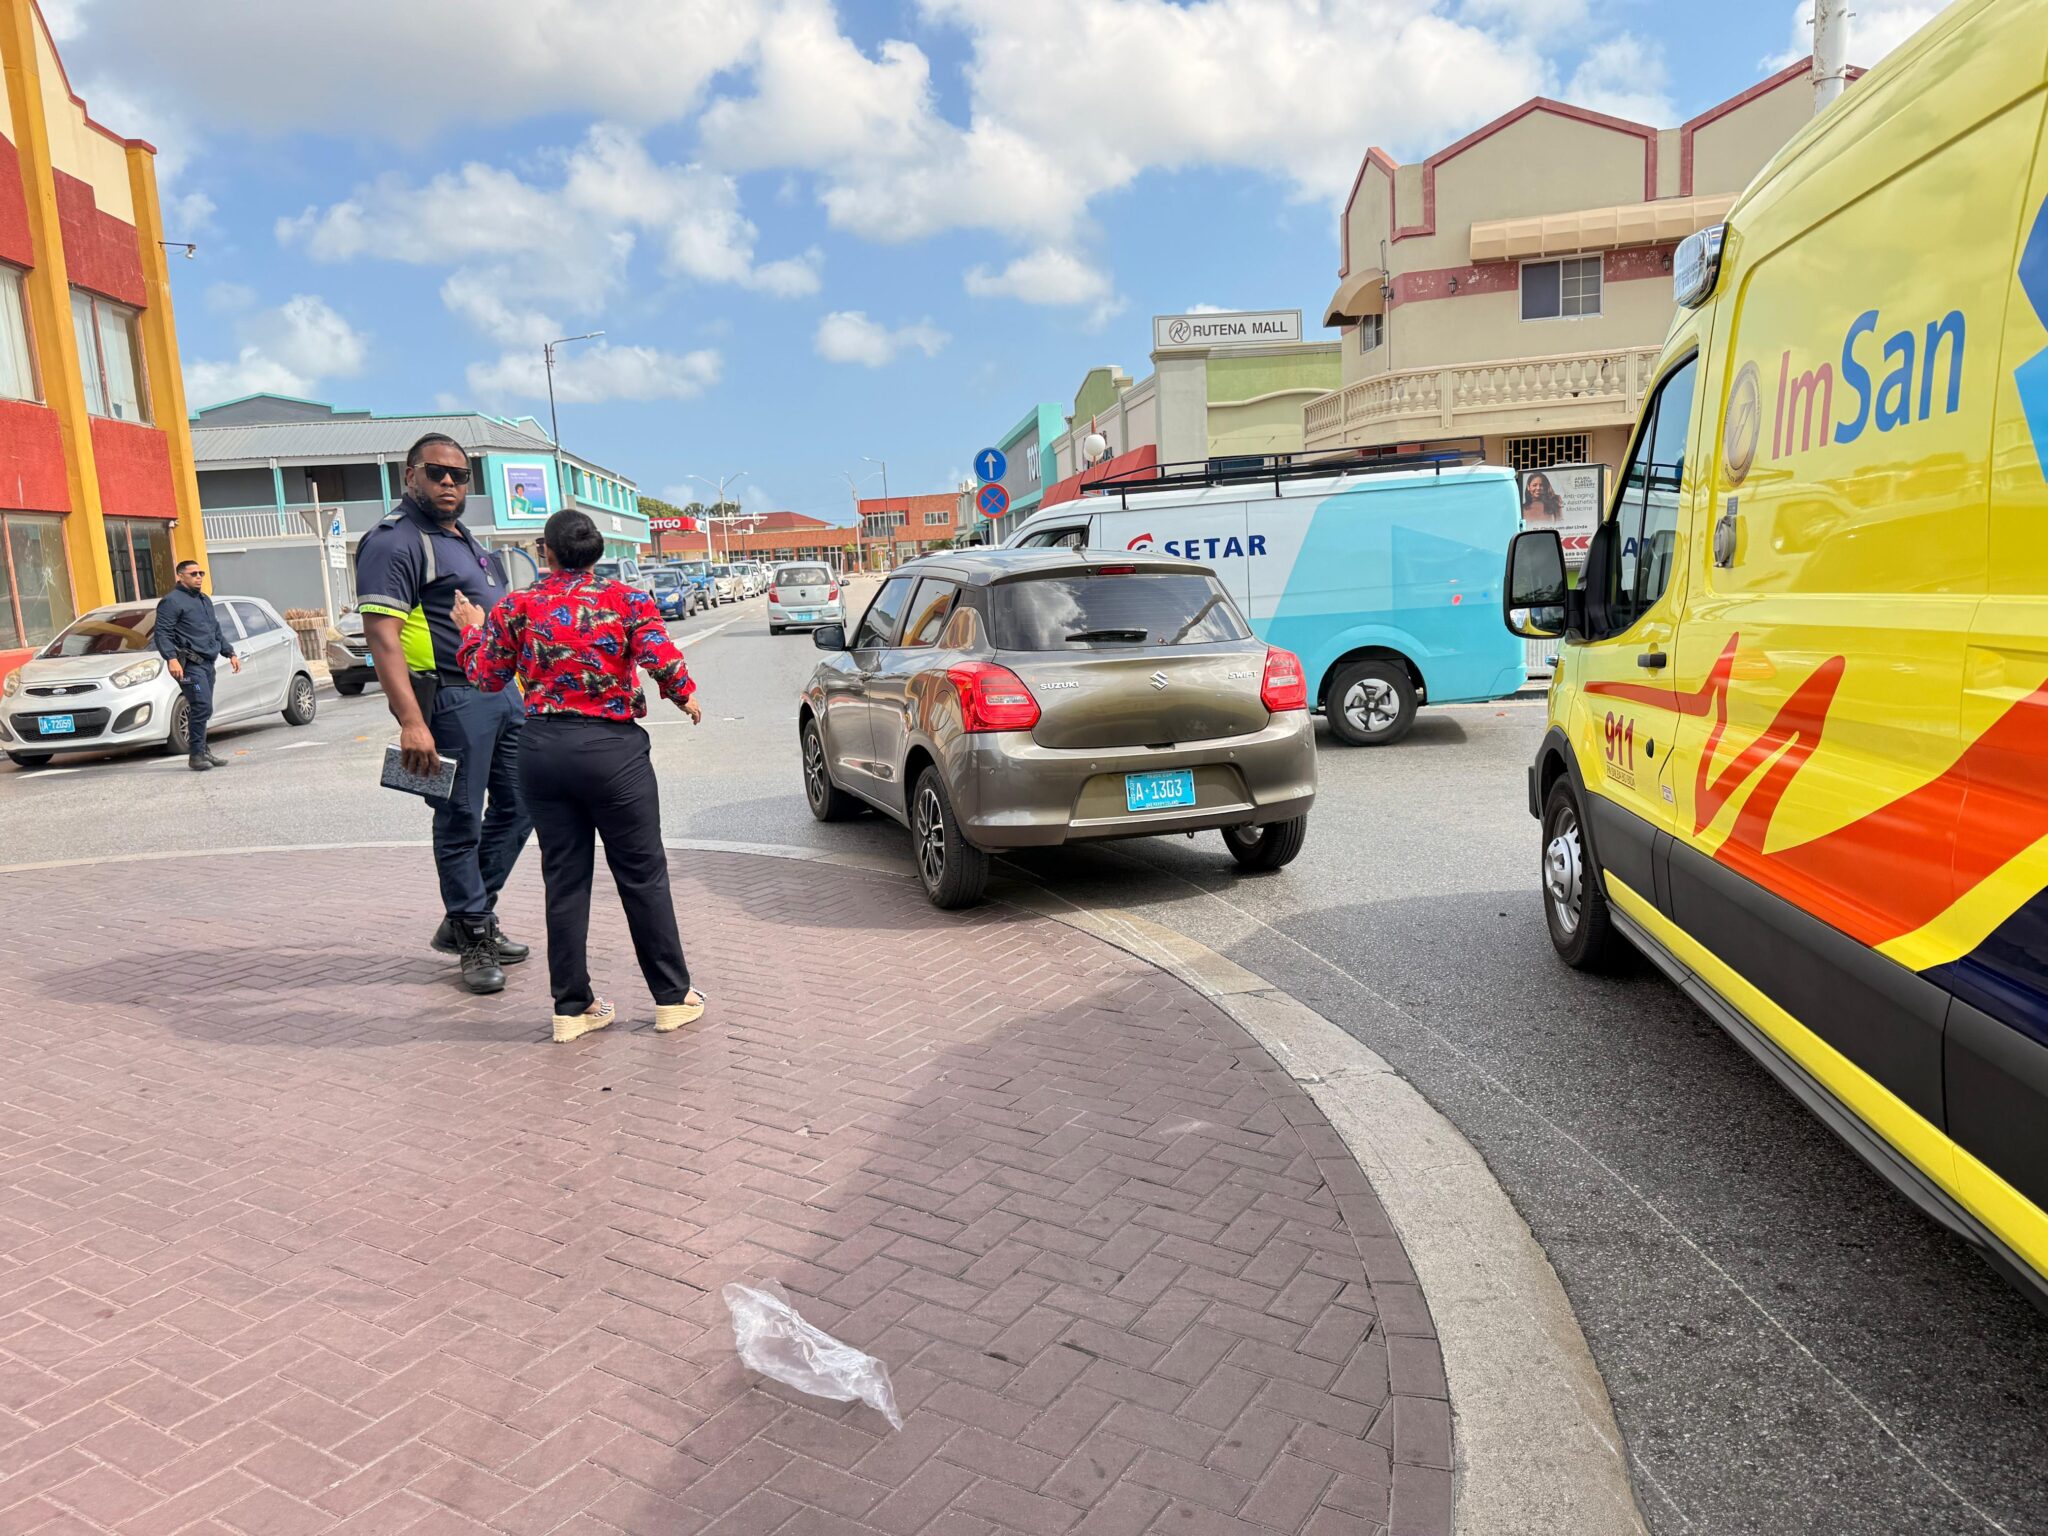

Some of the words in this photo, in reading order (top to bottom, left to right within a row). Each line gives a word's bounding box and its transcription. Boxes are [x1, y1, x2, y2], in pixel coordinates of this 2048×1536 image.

[1193, 324, 1247, 337] RUTENA
[1252, 321, 1288, 334] MALL
[1772, 309, 1966, 461] ImSan
[649, 519, 681, 530] CITGO
[1164, 534, 1267, 560] SETAR
[1040, 681, 1080, 690] SUZUKI
[1605, 711, 1634, 771] 911
